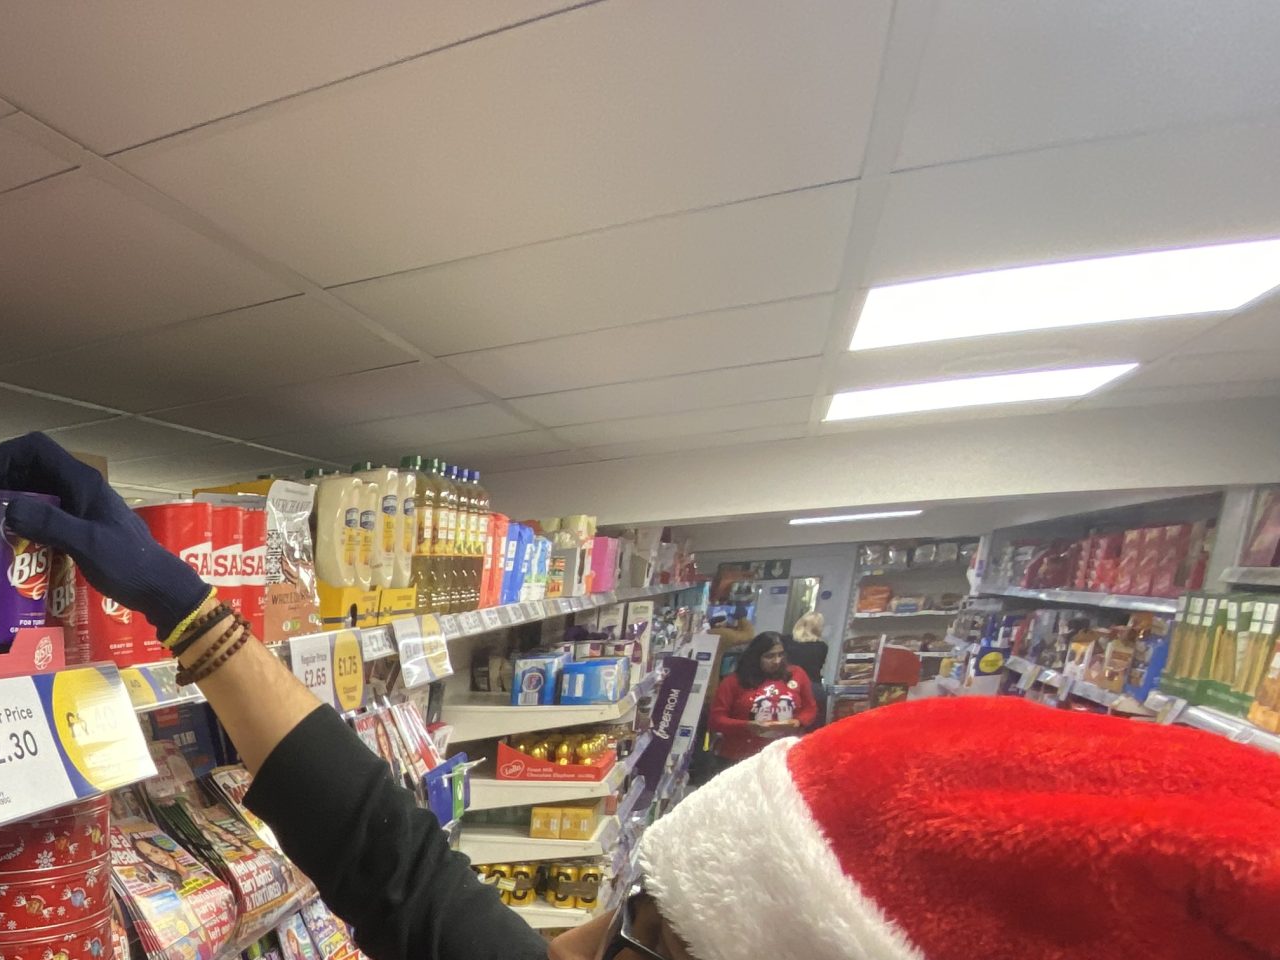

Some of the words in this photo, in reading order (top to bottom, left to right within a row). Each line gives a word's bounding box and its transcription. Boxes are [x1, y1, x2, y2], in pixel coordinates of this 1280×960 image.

[11, 550, 47, 587] BIS
[338, 656, 358, 676] £1.75
[304, 667, 326, 687] £2.65
[6, 706, 33, 721] Price
[653, 689, 680, 739] freeFROM
